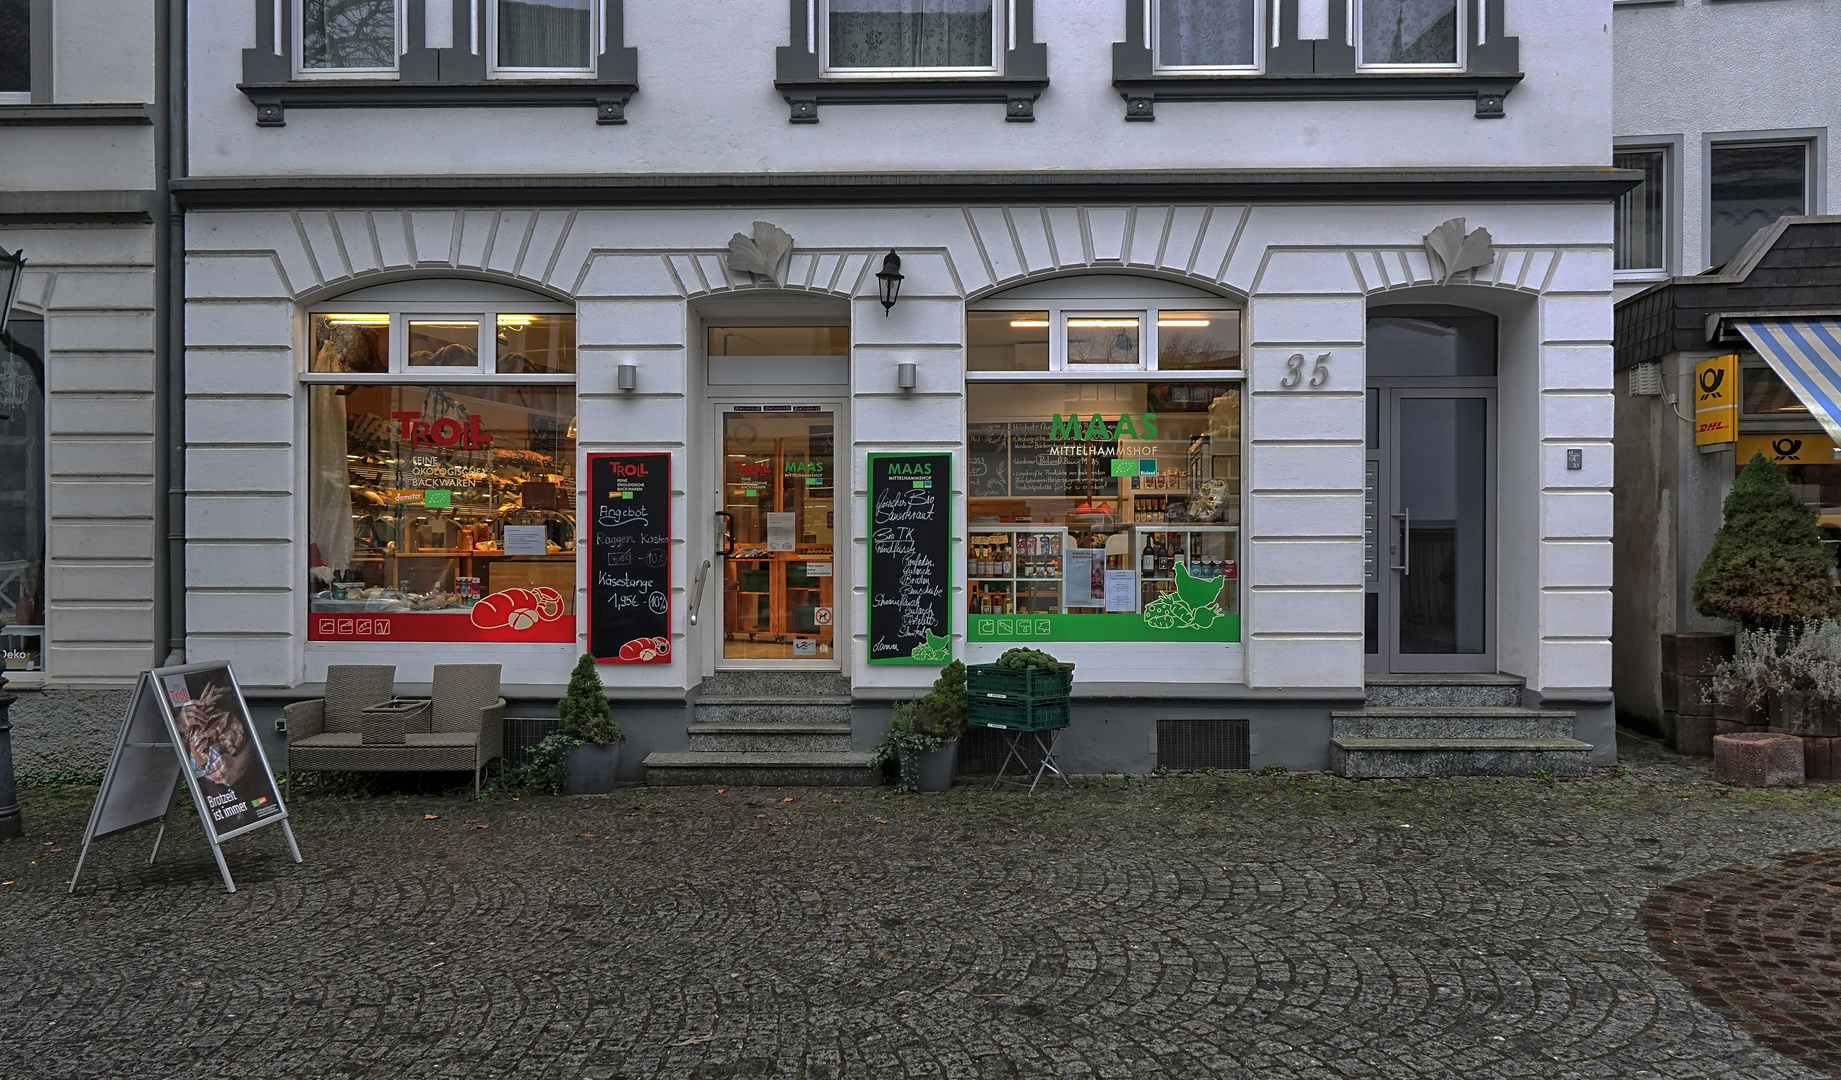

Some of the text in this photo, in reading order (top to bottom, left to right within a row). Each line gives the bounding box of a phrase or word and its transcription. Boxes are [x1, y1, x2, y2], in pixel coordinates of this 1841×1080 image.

[1282, 352, 1331, 387] 35
[392, 412, 492, 449] TROLL
[1050, 412, 1158, 440] MAAS
[1700, 421, 1723, 432] DHL
[1050, 446, 1157, 456] MITTELHAMMSHOF
[413, 457, 438, 465] FEINE
[734, 461, 771, 476] TROLL
[785, 462, 823, 472] MAAS
[888, 463, 931, 474] MAAS
[413, 467, 480, 476] ÖKOLOGISCHE
[609, 462, 648, 477] TROLL
[413, 479, 476, 487] BACKWAREN
[395, 493, 421, 501] demeter
[904, 489, 934, 505] Bio
[600, 505, 648, 522] Angebot
[897, 527, 914, 540] TK
[599, 571, 653, 594] Käsestange
[608, 593, 639, 610] 1,95€
[169, 690, 189, 701] Troll
[206, 789, 237, 808] Brotzeit
[212, 806, 224, 821] ist
[224, 801, 248, 818] immer
